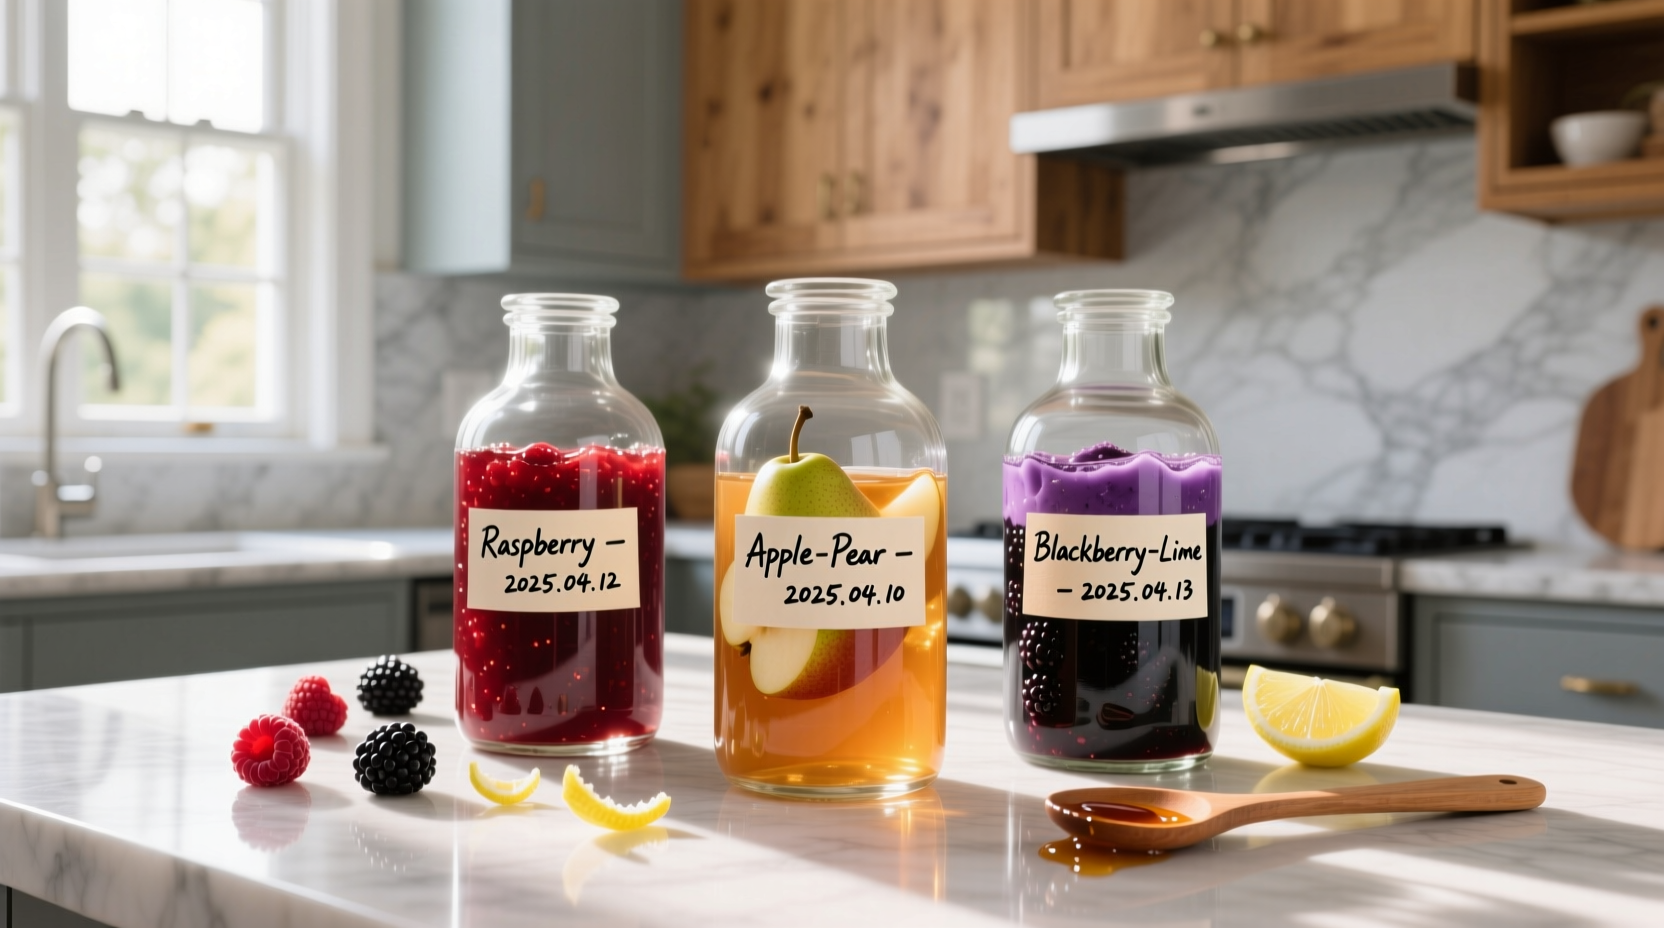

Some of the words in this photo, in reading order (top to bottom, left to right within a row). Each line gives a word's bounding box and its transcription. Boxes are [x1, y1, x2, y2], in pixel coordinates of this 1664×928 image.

[481, 524, 597, 569] Raspberry
[744, 531, 887, 579] Apple-Pear
[1033, 530, 1203, 576] Blackberry-Lime
[504, 572, 622, 594] 2025.04.12
[783, 583, 906, 607] 2025.04.10
[1080, 579, 1194, 602] 2025.04.13
